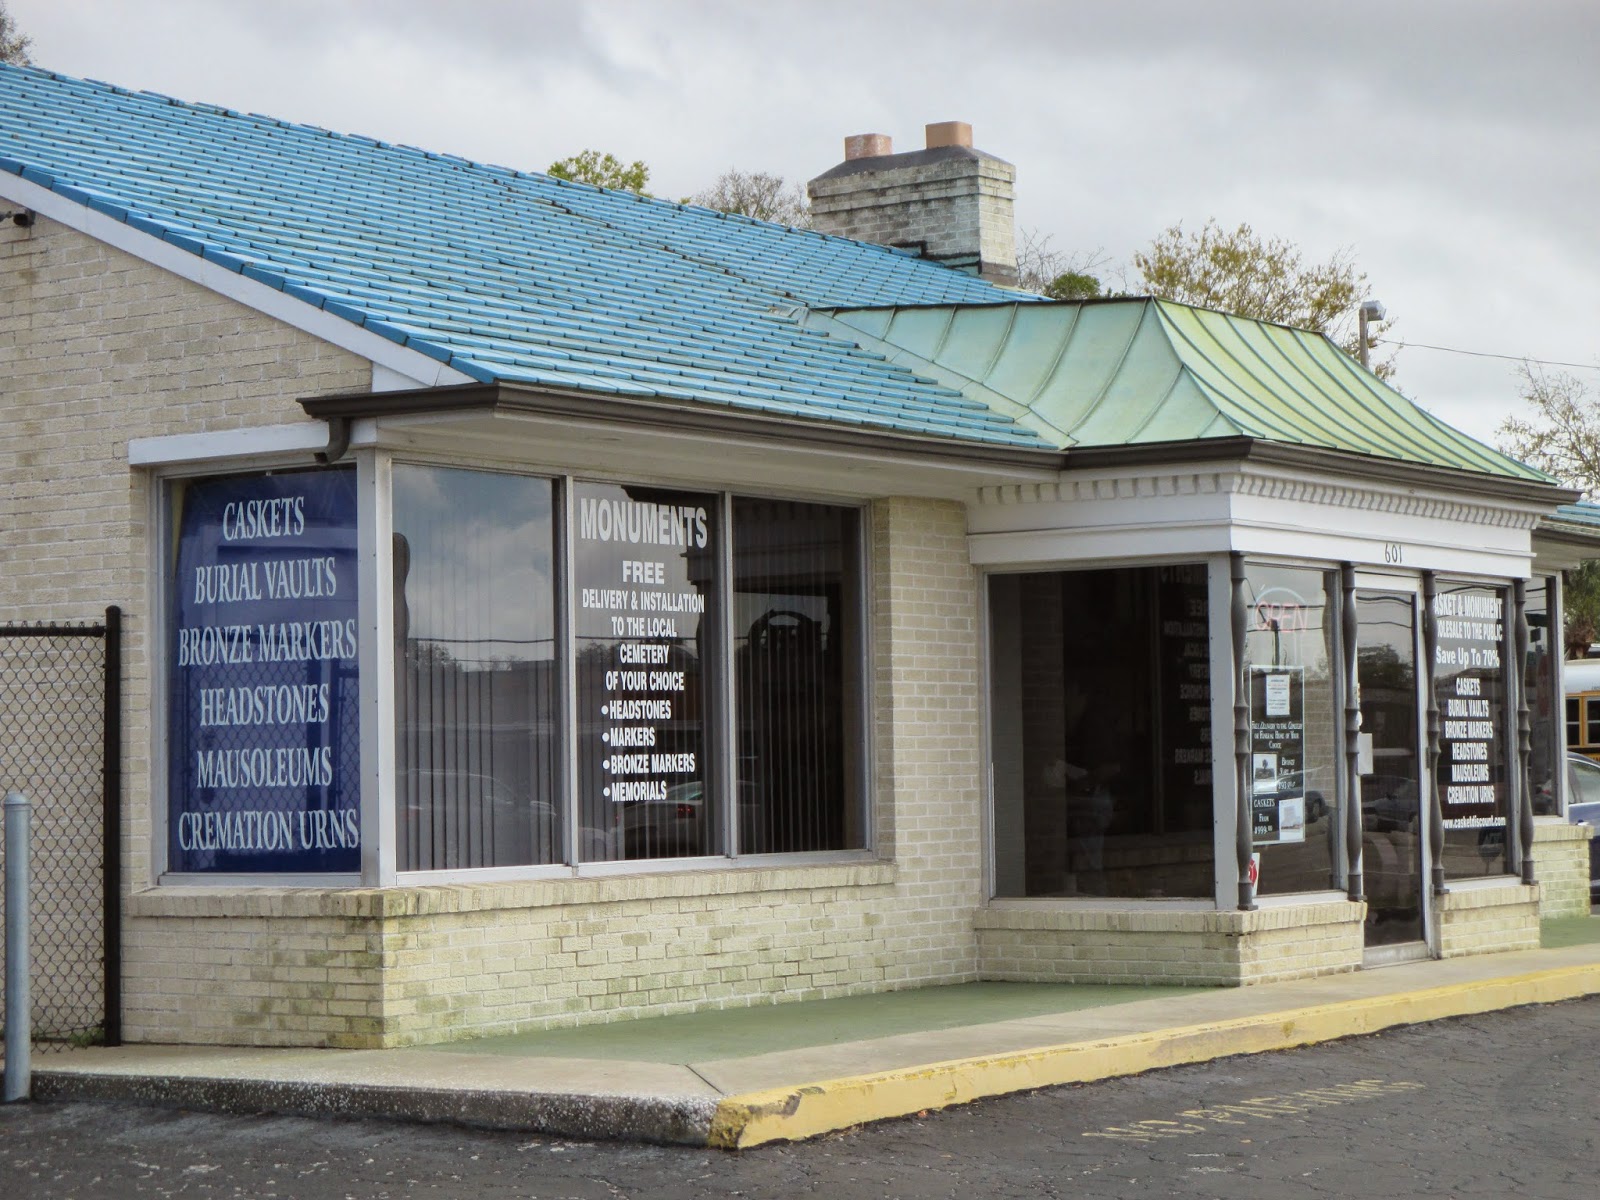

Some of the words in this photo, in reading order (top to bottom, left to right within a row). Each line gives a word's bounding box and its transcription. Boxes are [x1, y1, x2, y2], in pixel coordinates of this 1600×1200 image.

[223, 496, 304, 541] CASKETS
[581, 498, 708, 548] MONUMENTS
[1385, 542, 1402, 563] 601
[194, 562, 261, 604] BURIAL
[264, 557, 336, 599] VAULTS
[622, 560, 664, 584] FREE
[582, 589, 628, 609] DELIVERY
[631, 591, 638, 610] &
[641, 592, 704, 613] INSTALLATION
[1434, 592, 1457, 615] ASKET
[1464, 596, 1502, 619] MONUMENT
[612, 616, 624, 636] TO
[627, 617, 644, 636] THE
[648, 618, 677, 637] LOCAL
[1256, 600, 1308, 632] OPEN
[1437, 620, 1462, 639] OLESALE
[1464, 622, 1470, 639] TO
[1472, 623, 1482, 639] THE
[1483, 623, 1502, 641] PUBLIC
[178, 625, 252, 666] BRONZE
[258, 619, 356, 662] MARKERS
[620, 644, 670, 664] CEMETERY
[1436, 646, 1456, 664] Save
[1458, 647, 1469, 669] Up
[1471, 648, 1480, 666] To
[1483, 649, 1500, 667] 70%
[606, 671, 618, 690] OF
[621, 671, 647, 690] YOUR
[650, 672, 684, 690] CHOICE
[1456, 678, 1480, 696] CASKETS
[200, 683, 329, 726] HEADSTONES
[610, 700, 671, 720] HEADSTONES
[1448, 699, 1468, 717] BURIAL
[1468, 699, 1489, 717] VAULTS
[610, 727, 655, 746] MARKERS
[1445, 721, 1467, 738] BRONZE
[1468, 721, 1493, 738] MARKERS
[1452, 742, 1487, 760] HEADSTONES
[197, 746, 332, 788] MAUSOLEUMS
[611, 754, 649, 774] BRONZE
[652, 753, 695, 772] MARKERS
[1452, 764, 1489, 782] MAUSOLEUMS
[612, 780, 667, 801] MEMORIALS
[1448, 785, 1479, 804] CREMATION
[1480, 785, 1494, 803] URNS
[1254, 798, 1275, 808] CASKETS
[178, 810, 293, 850] CREMATION
[299, 809, 359, 849] URNS
